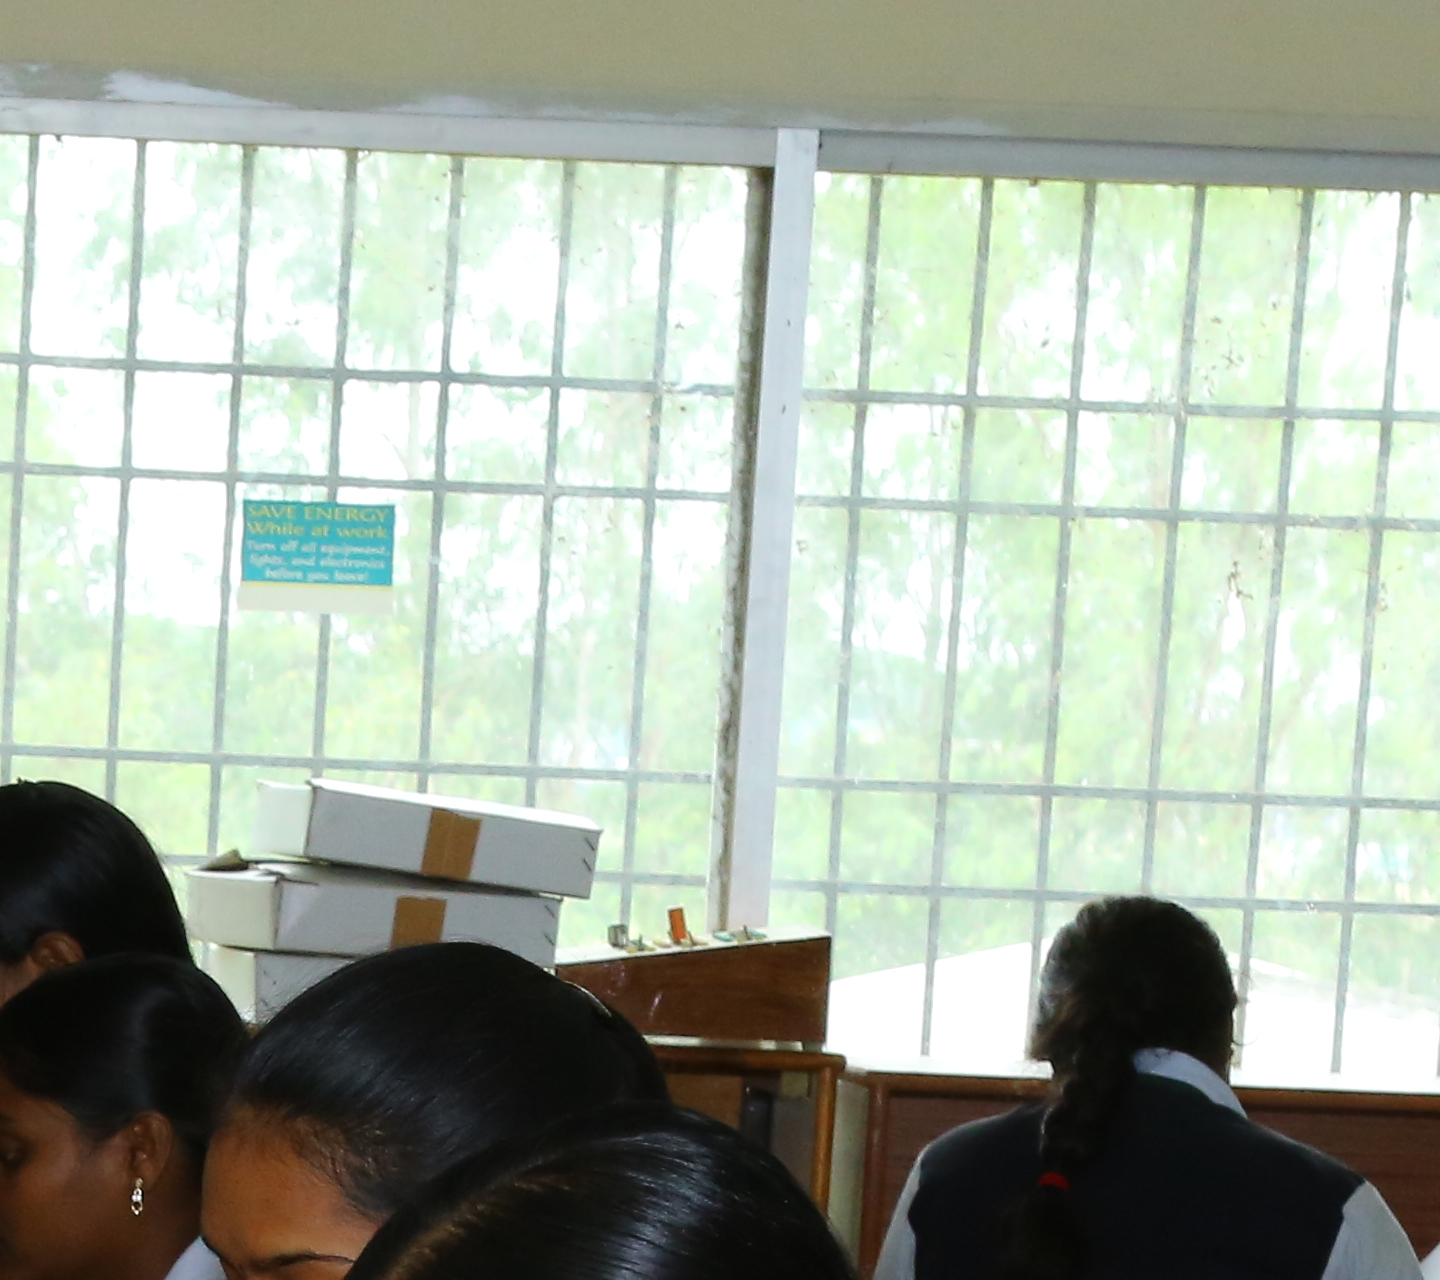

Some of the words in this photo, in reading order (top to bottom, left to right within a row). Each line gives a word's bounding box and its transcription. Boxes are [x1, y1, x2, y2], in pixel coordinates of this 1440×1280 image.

[247, 504, 296, 519] SAVE
[304, 506, 388, 522] ENERGY
[247, 521, 304, 536] While
[312, 525, 330, 537] at
[337, 525, 388, 538] work
[280, 540, 299, 552] off
